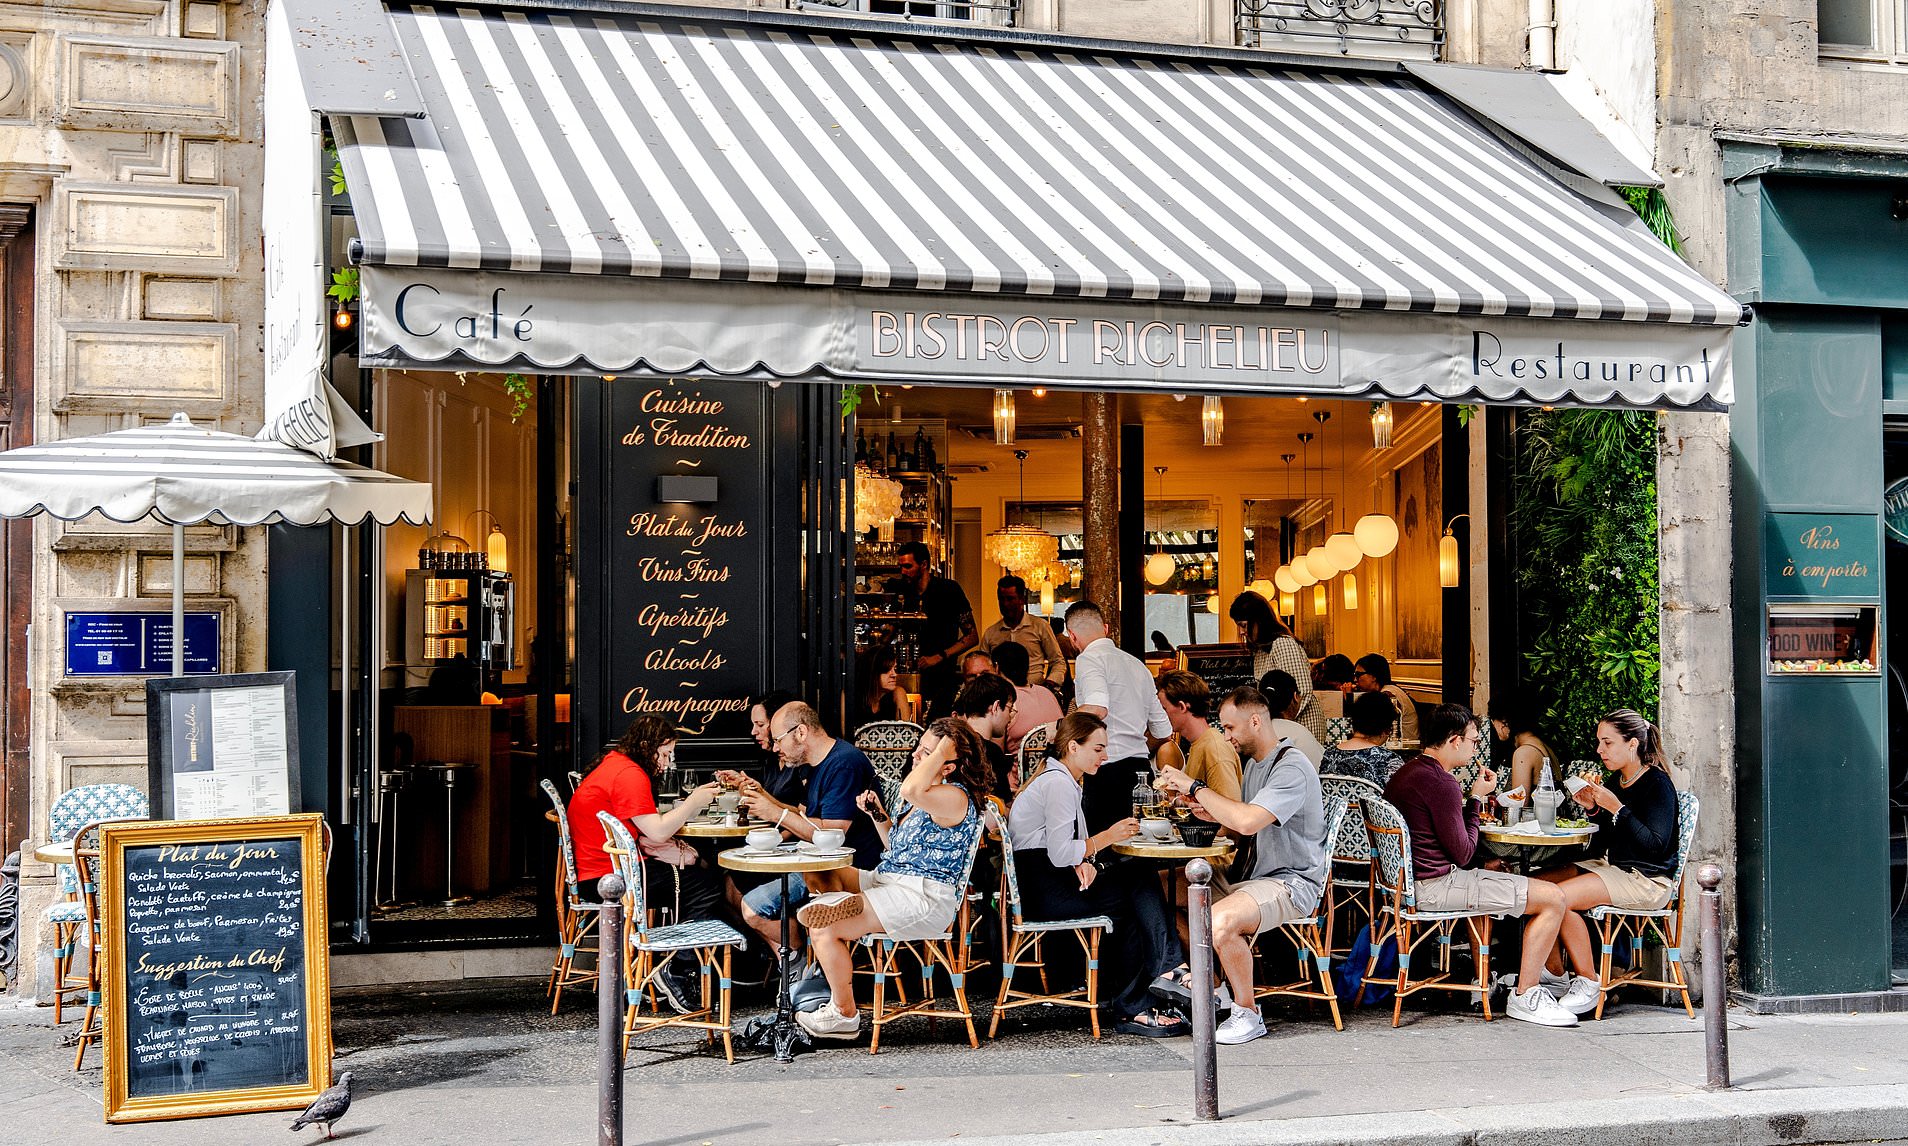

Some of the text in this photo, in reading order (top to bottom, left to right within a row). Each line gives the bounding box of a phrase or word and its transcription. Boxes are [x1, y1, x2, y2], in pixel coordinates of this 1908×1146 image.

[395, 283, 533, 341] Café
[870, 310, 1329, 374] BISTROT RICHELIEU
[1472, 330, 1712, 383] Restaurant
[640, 389, 724, 415] Cuisine
[622, 418, 750, 448] de Tradition
[626, 512, 747, 547] Plat du Jour
[1800, 526, 1840, 550] Vins
[638, 557, 731, 582] Vins Fins
[1782, 558, 1869, 588] à emporter
[637, 604, 728, 639] Apéritifs
[1805, 633, 1842, 652] WINE
[644, 648, 727, 670] Alcools
[622, 686, 750, 723] Champagnes
[158, 844, 199, 863] Plat
[205, 844, 228, 860] du
[129, 868, 158, 882] Quiche
[137, 883, 166, 893] Salade
[242, 889, 253, 898] de
[164, 904, 207, 917] parmesan
[174, 919, 186, 929] de
[141, 931, 201, 946] Salade Verte
[133, 946, 286, 981] Suggestion du Chef
